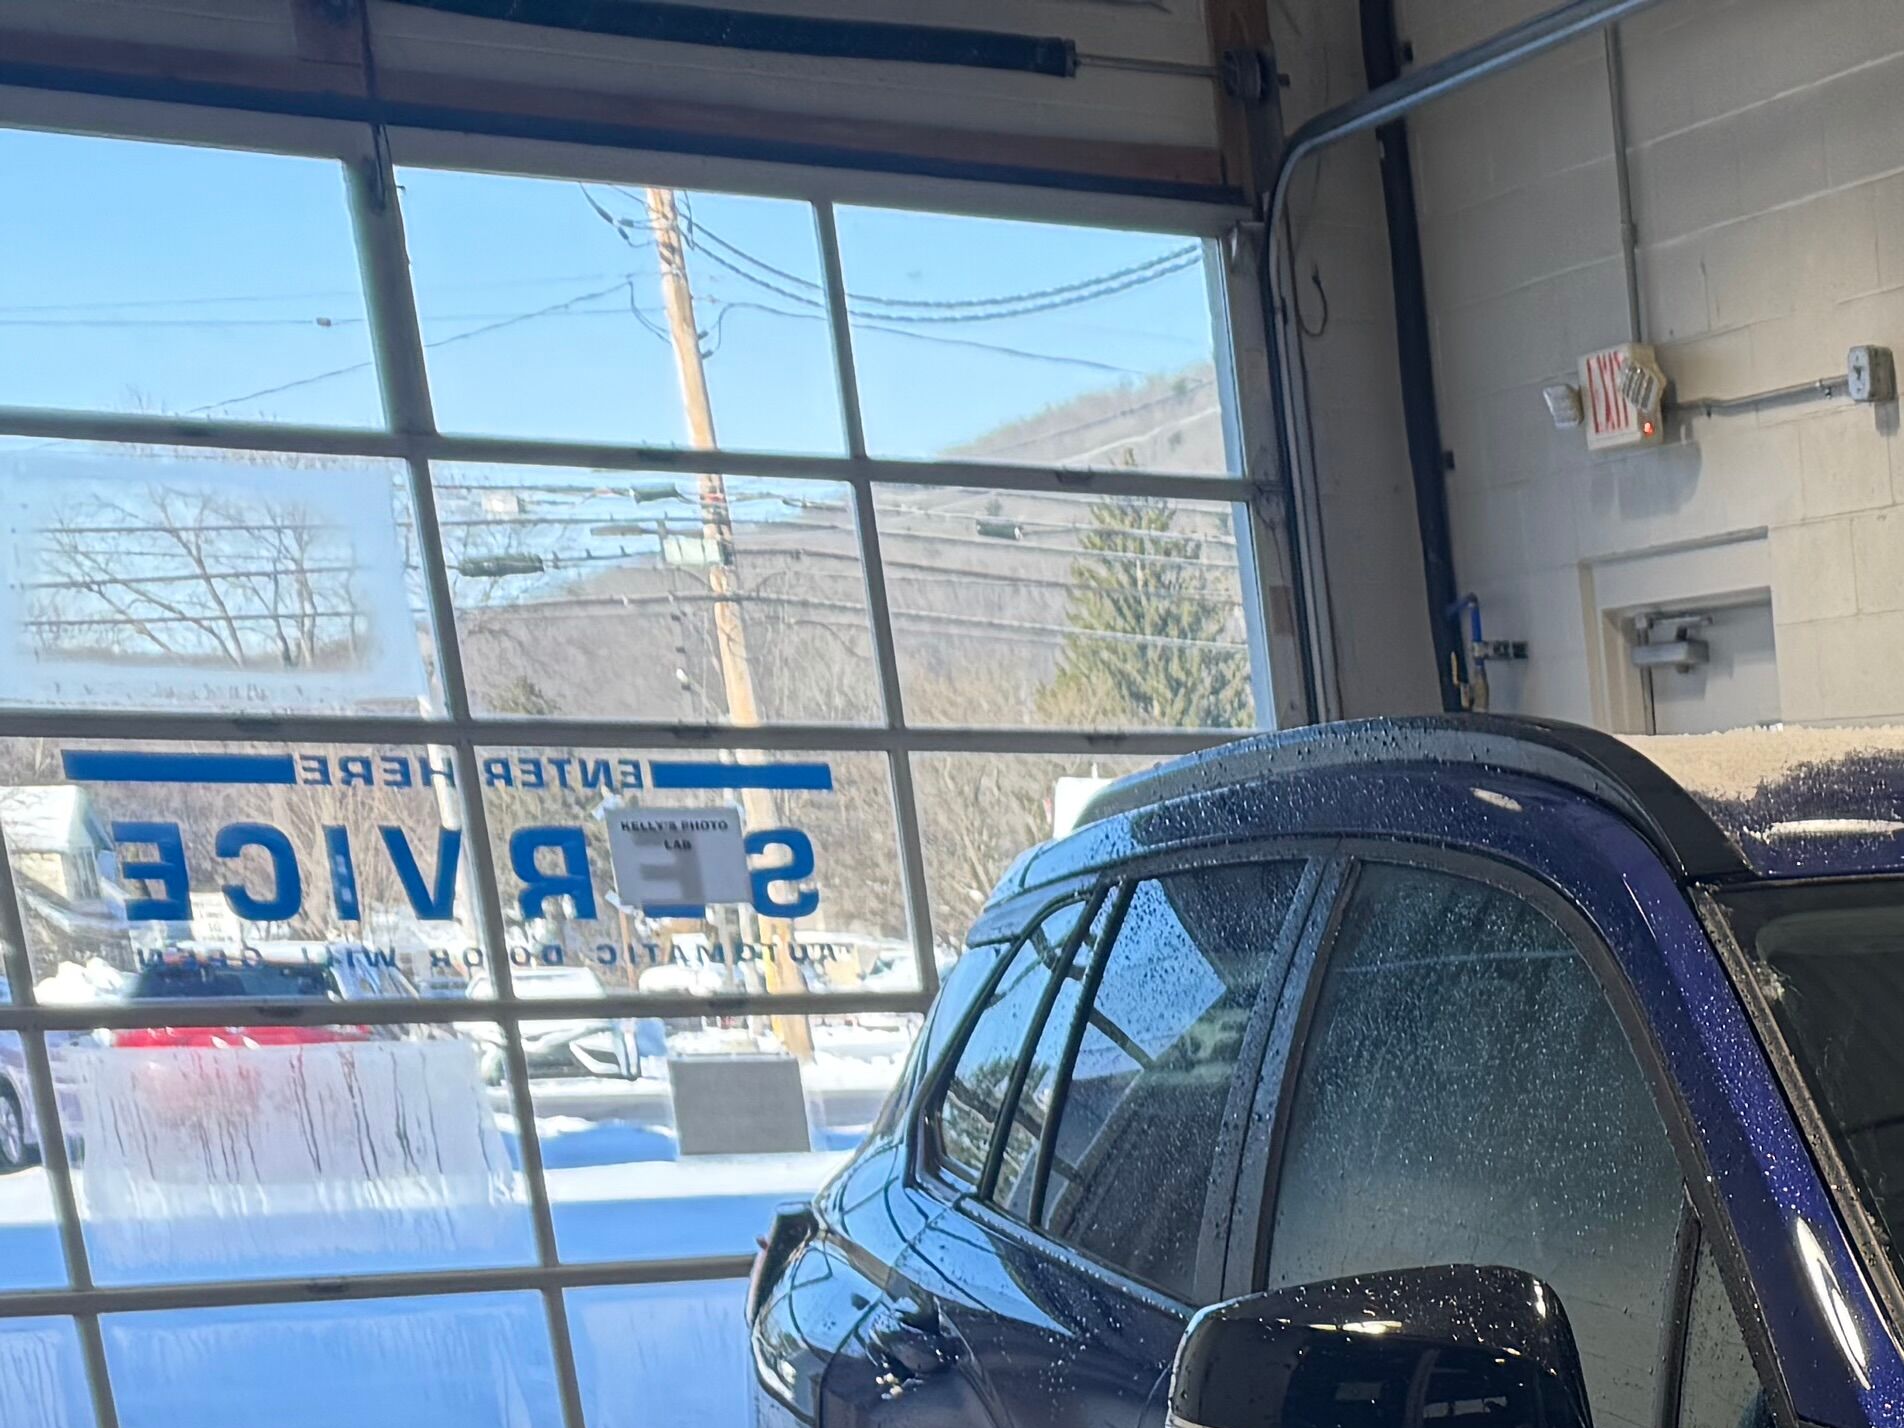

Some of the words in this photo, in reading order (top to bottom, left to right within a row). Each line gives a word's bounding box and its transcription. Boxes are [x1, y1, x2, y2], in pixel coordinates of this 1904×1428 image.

[620, 820, 677, 833] KELLY'S
[680, 820, 729, 832] PHOTO
[663, 839, 692, 851] LAB
